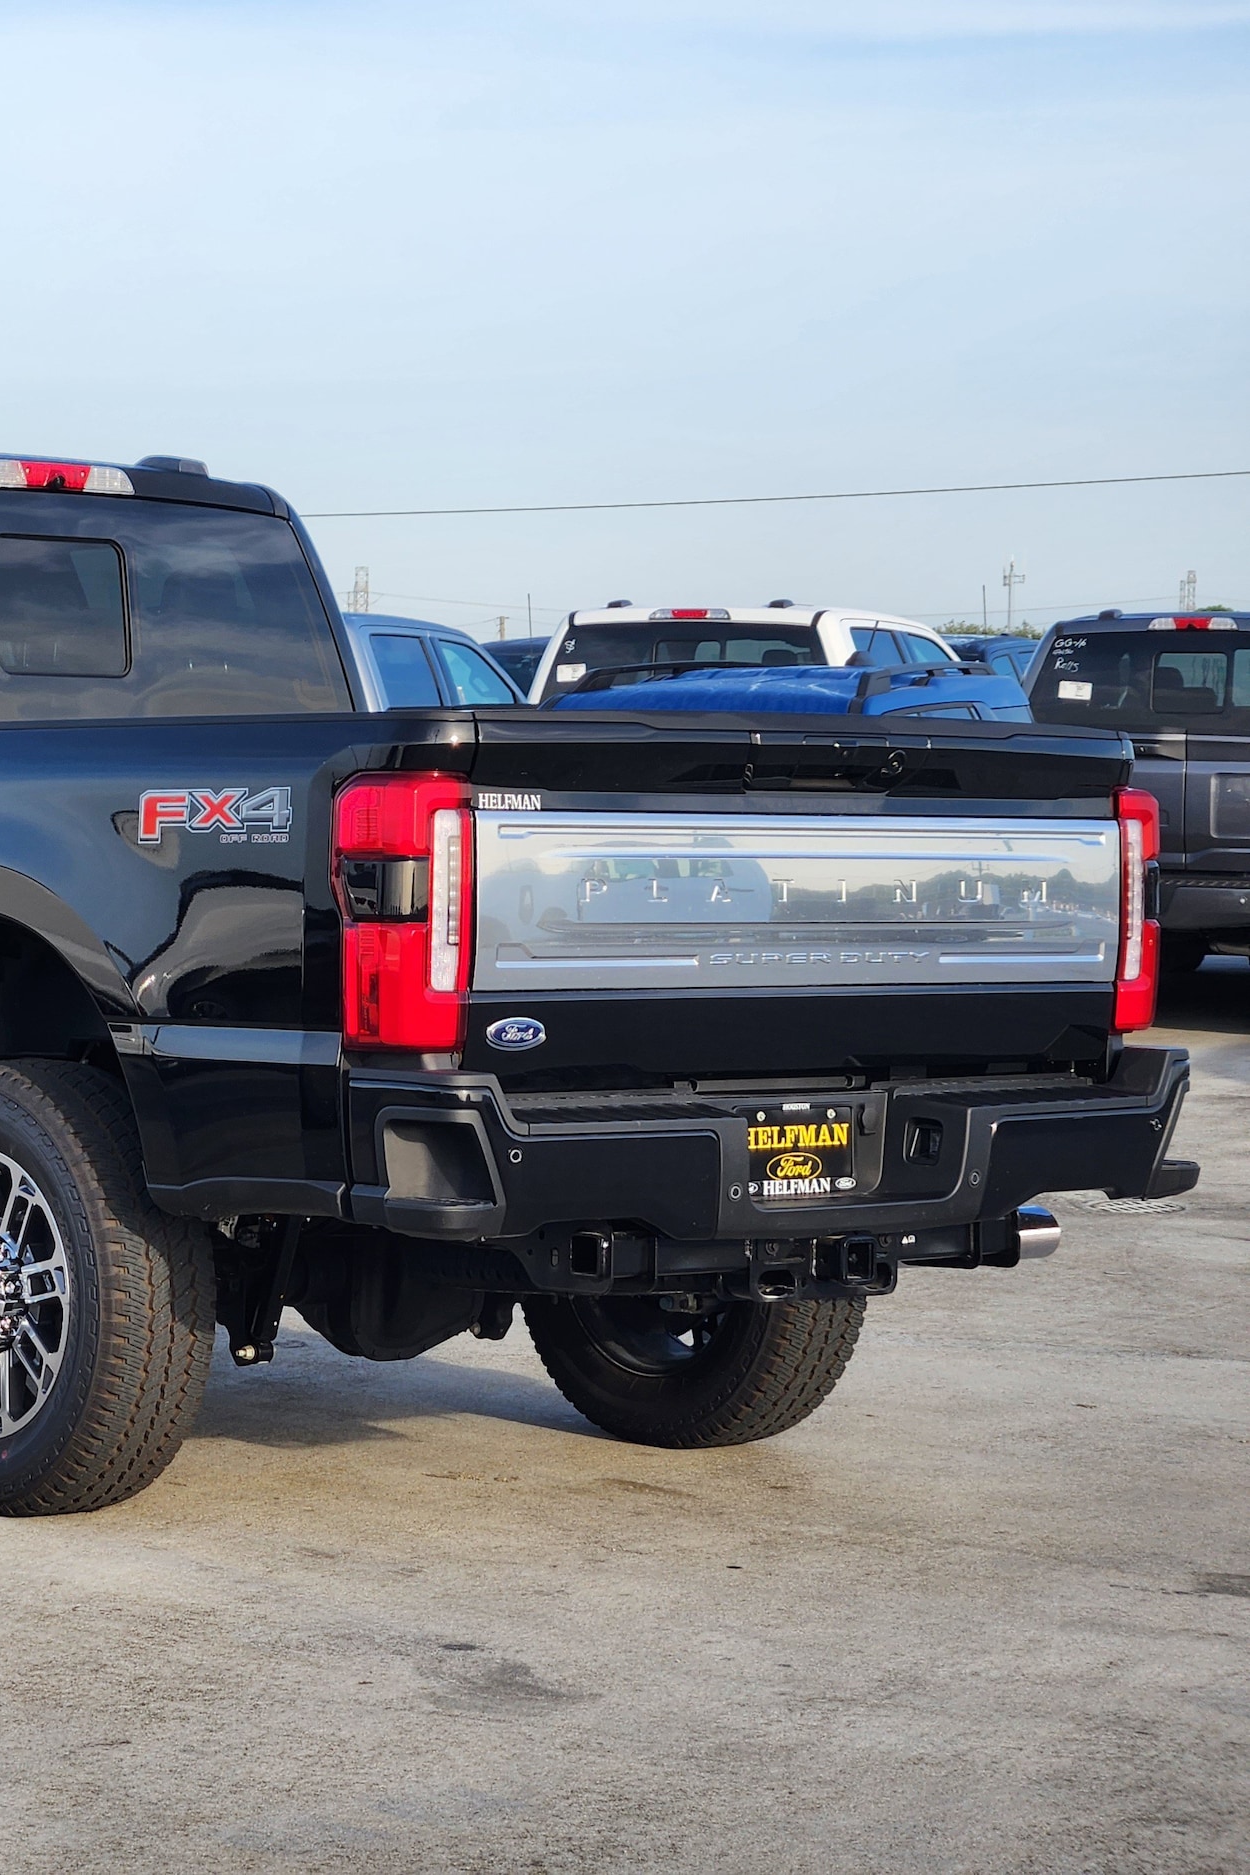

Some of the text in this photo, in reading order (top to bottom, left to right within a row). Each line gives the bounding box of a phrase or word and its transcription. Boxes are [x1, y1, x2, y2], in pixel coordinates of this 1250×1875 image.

[477, 793, 541, 810] HELFMAN
[137, 786, 293, 844] FX4
[219, 834, 289, 843] OFF ROAD
[580, 878, 1048, 903] PLATINUM
[709, 951, 930, 965] SUPER DUTY
[776, 1156, 812, 1177] Ford
[762, 1178, 831, 1196] HELFMAN
